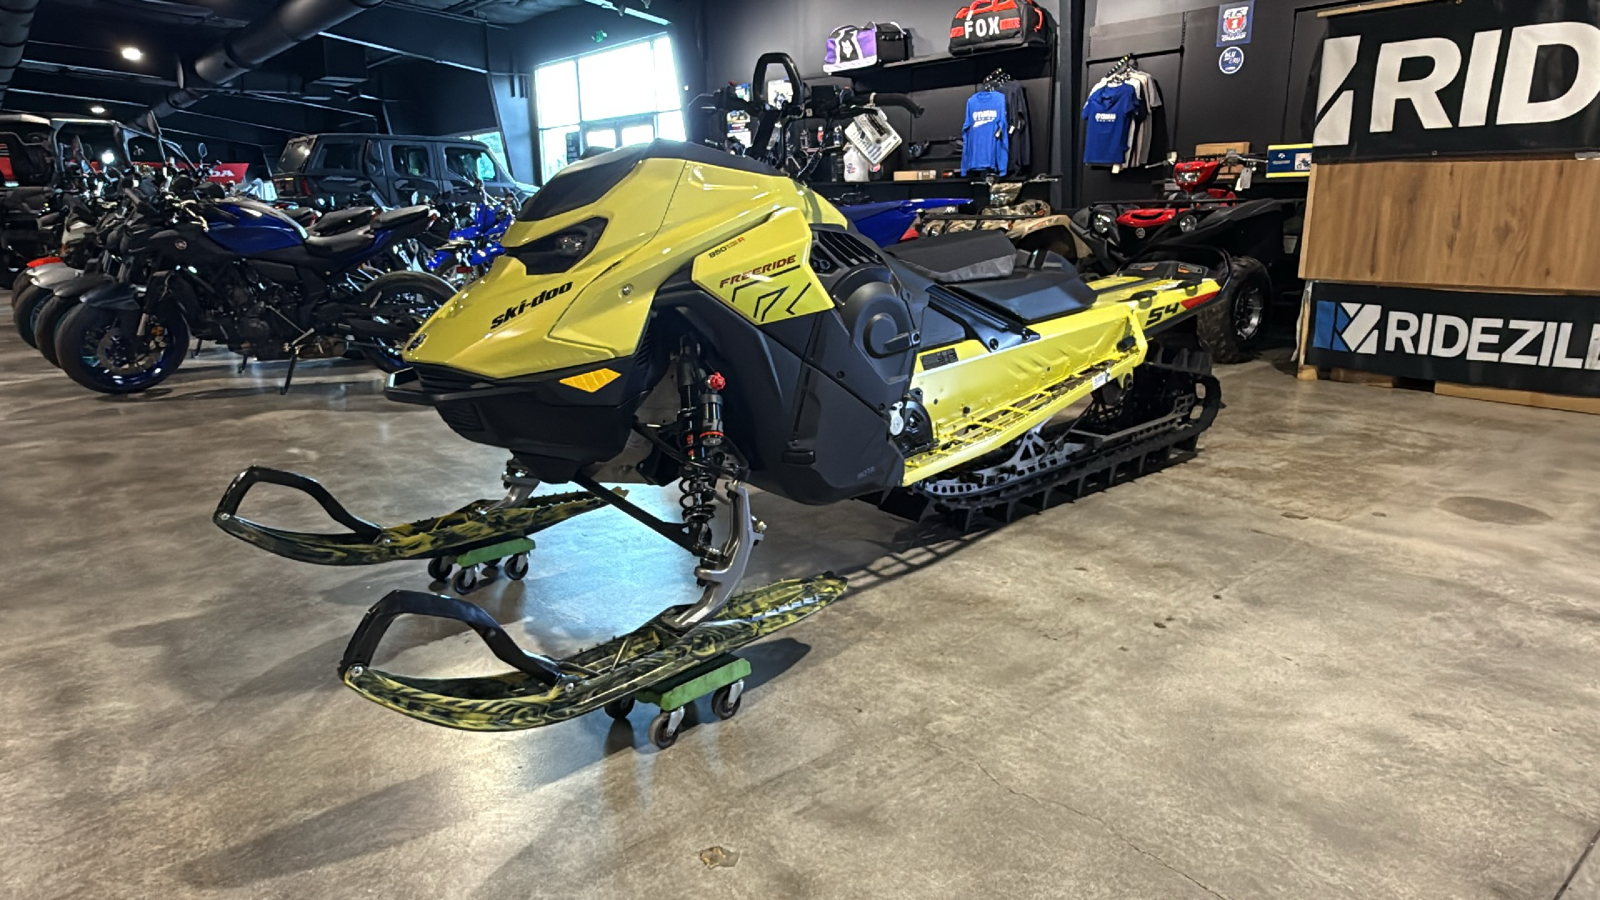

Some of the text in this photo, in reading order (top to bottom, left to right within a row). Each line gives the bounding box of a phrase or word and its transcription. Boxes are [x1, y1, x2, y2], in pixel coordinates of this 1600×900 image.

[964, 16, 1000, 39] FOX
[1369, 21, 1600, 133] RID
[719, 254, 797, 289] FREERIDE
[490, 281, 574, 330] ski-doo
